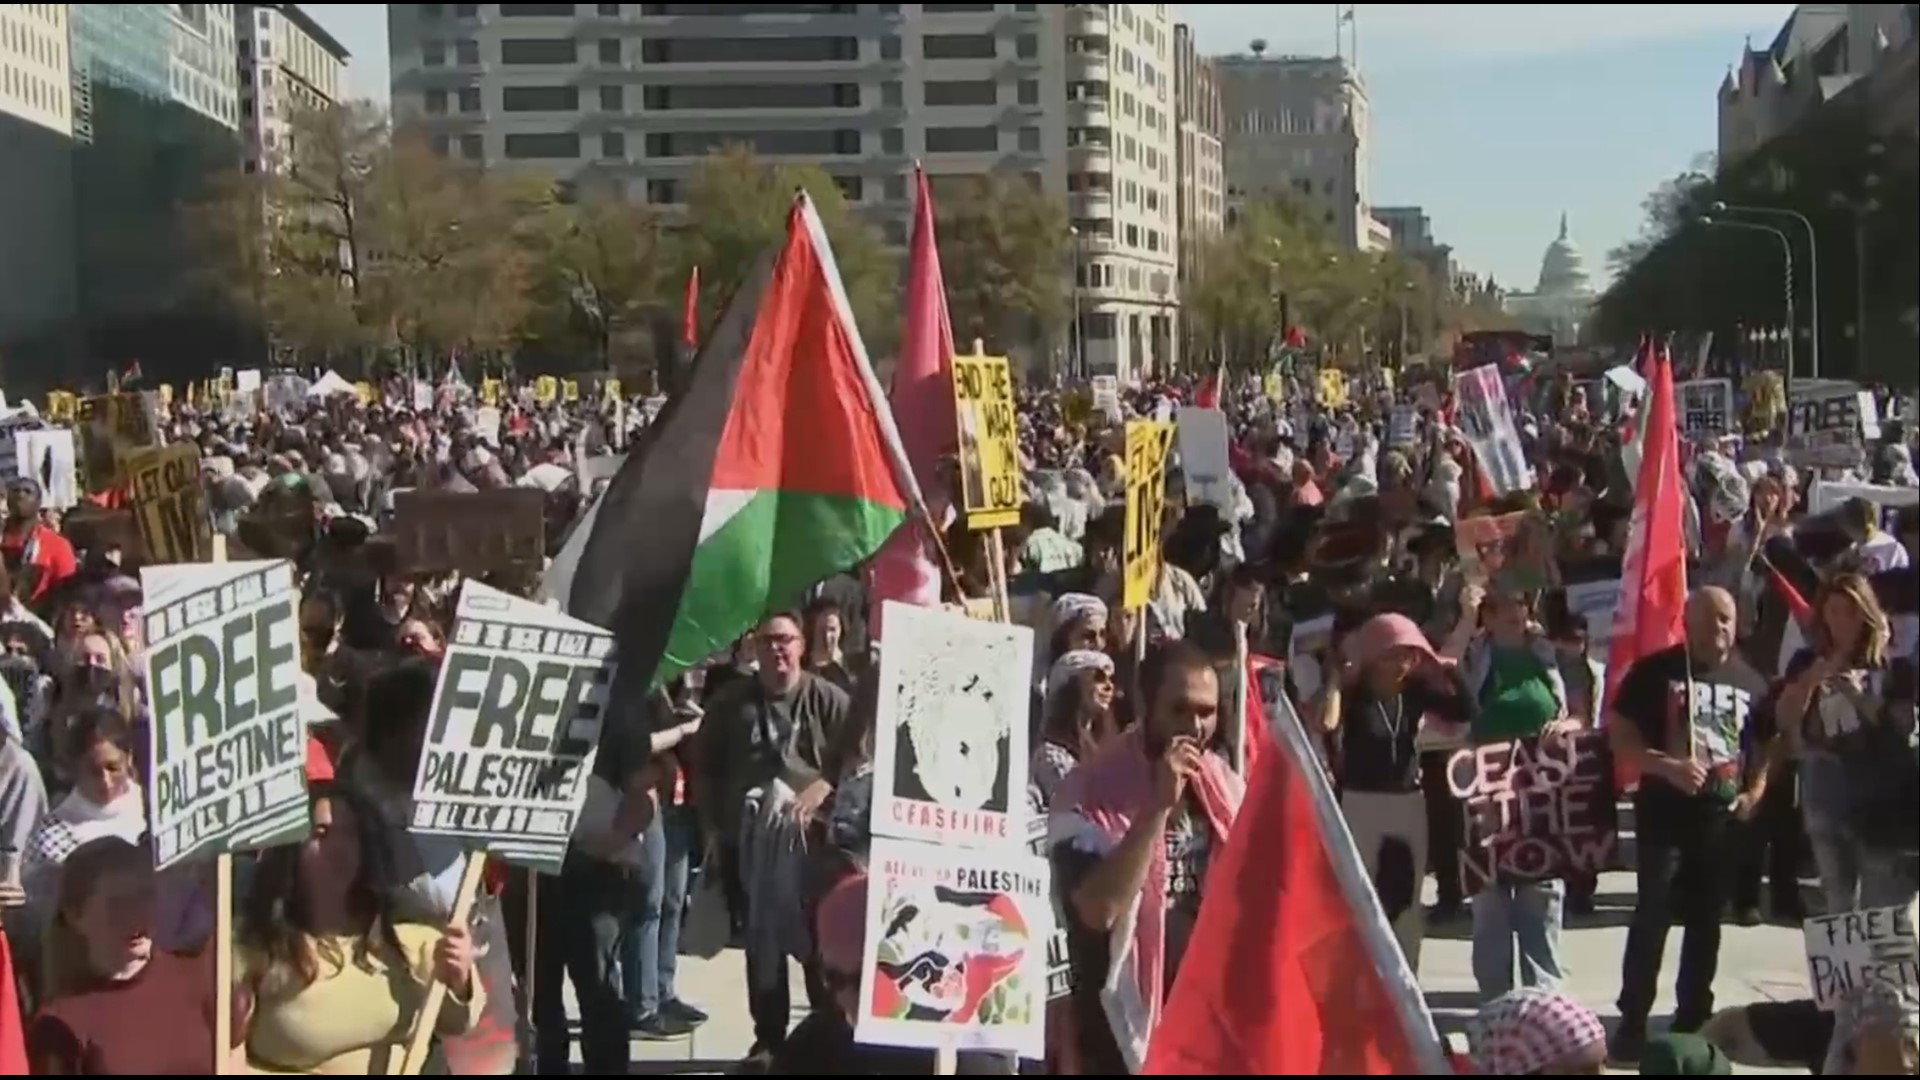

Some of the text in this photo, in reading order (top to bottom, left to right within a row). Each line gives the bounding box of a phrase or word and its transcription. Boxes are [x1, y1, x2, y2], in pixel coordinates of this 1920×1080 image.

[151, 600, 297, 766] FREE
[430, 652, 609, 756] FREE
[157, 708, 300, 825] PALESTINE!
[423, 751, 583, 801] PALESTINE!
[1447, 731, 1602, 797] CEASE
[1463, 784, 1594, 848] FIRE
[957, 867, 1041, 898] PALESTINE
[1458, 830, 1615, 896] NOW
[1812, 910, 1914, 946] FREE
